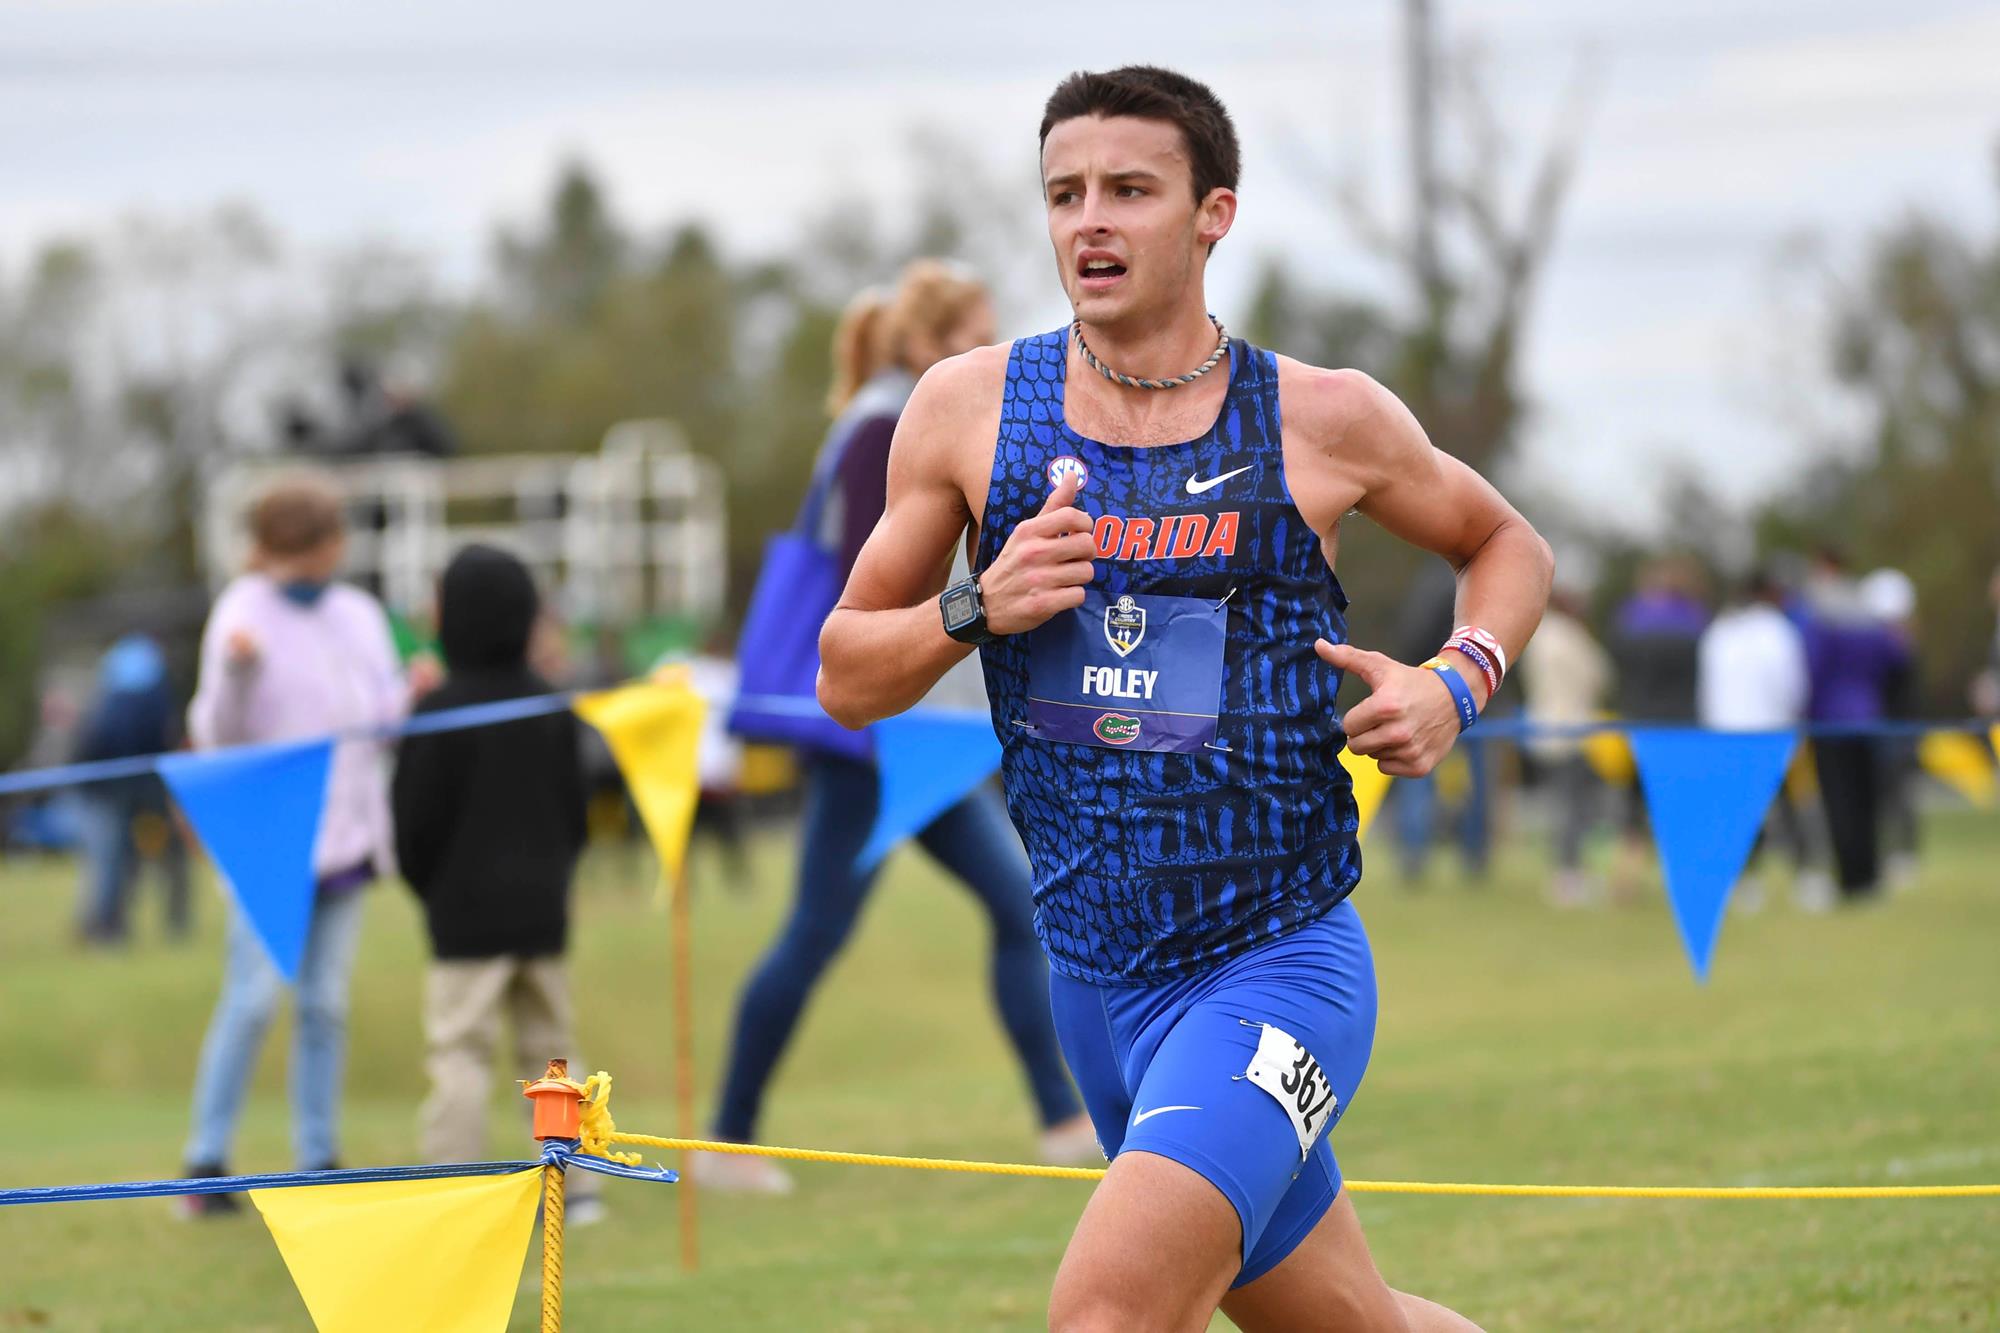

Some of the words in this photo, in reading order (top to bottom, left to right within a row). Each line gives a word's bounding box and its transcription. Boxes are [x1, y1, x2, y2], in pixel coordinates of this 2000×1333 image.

[1092, 511, 1240, 561] ORIDA
[1119, 597, 1133, 611] SEC
[1082, 665, 1159, 700] FOLEY
[1281, 1040, 1334, 1135] 362
